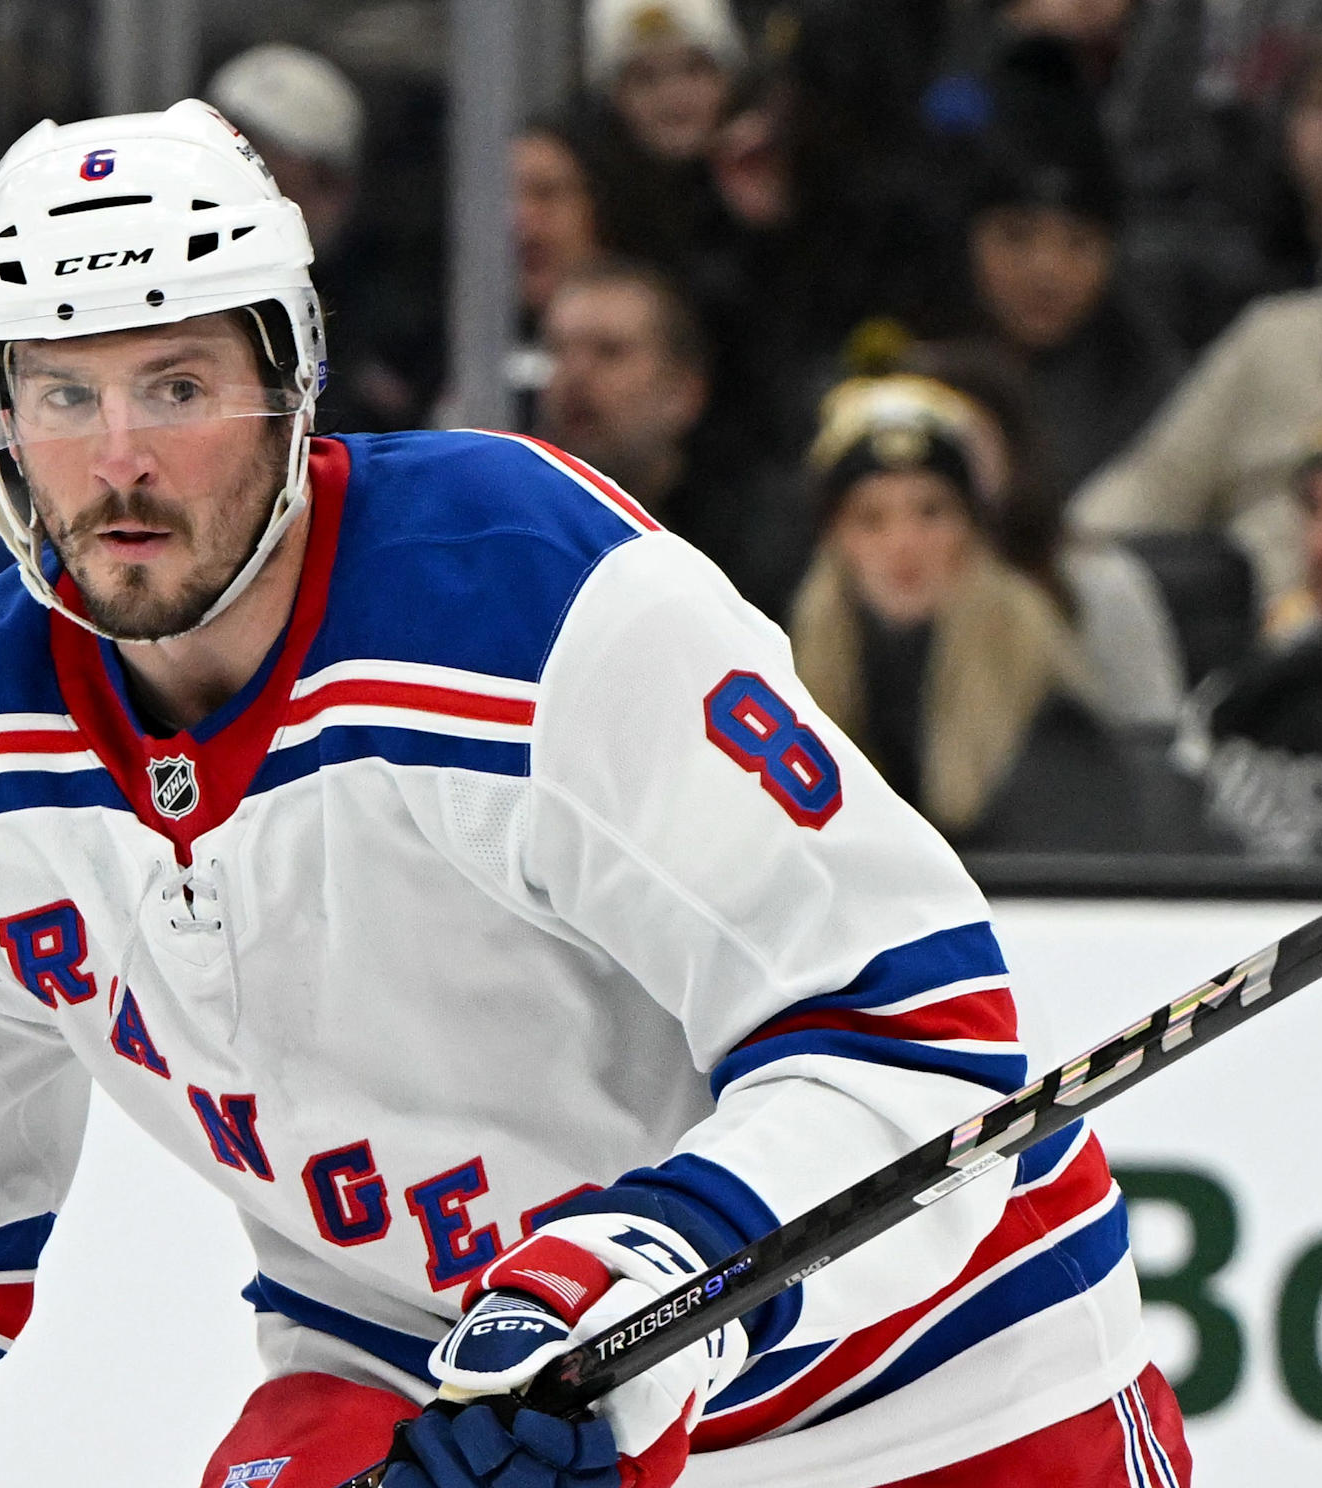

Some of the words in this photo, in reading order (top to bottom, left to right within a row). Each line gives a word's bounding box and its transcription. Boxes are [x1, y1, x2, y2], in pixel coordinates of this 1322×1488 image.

[55, 248, 154, 276] CCM
[703, 669, 843, 831] 8
[162, 770, 188, 806] NHL
[946, 941, 1279, 1168] CCM
[472, 1319, 545, 1337] CCM
[594, 1285, 704, 1361] TRIGGER
[704, 1274, 725, 1300] 9
